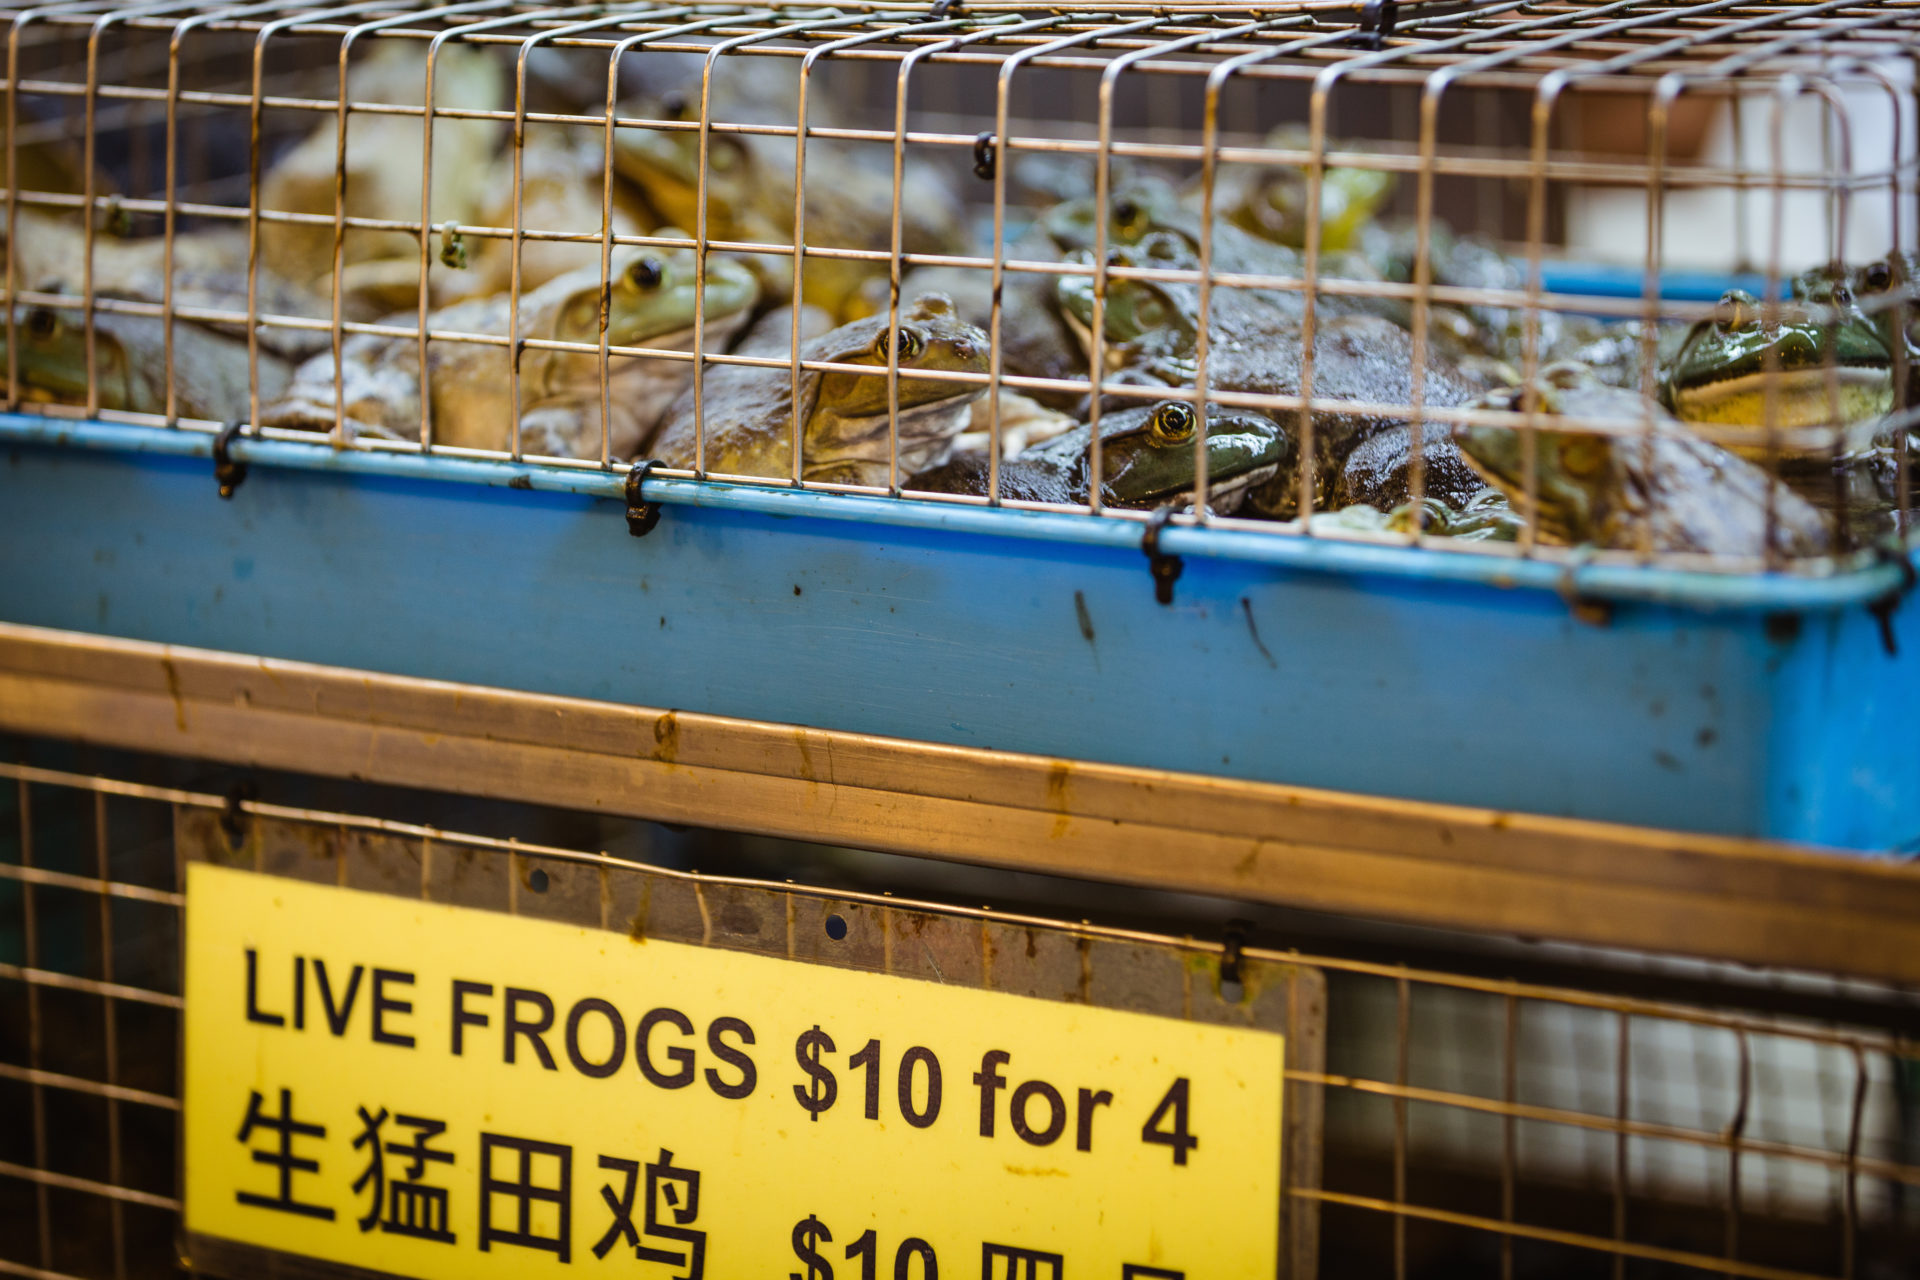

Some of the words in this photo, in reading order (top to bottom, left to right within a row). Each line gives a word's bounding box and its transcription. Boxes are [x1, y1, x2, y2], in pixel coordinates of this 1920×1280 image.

[245, 948, 417, 1050] LIVE
[451, 978, 758, 1101] FROGS
[791, 1023, 944, 1129] $10
[972, 1049, 1115, 1153] for
[1141, 1077, 1199, 1167] 4
[235, 1087, 708, 1280] 生猛田鸡
